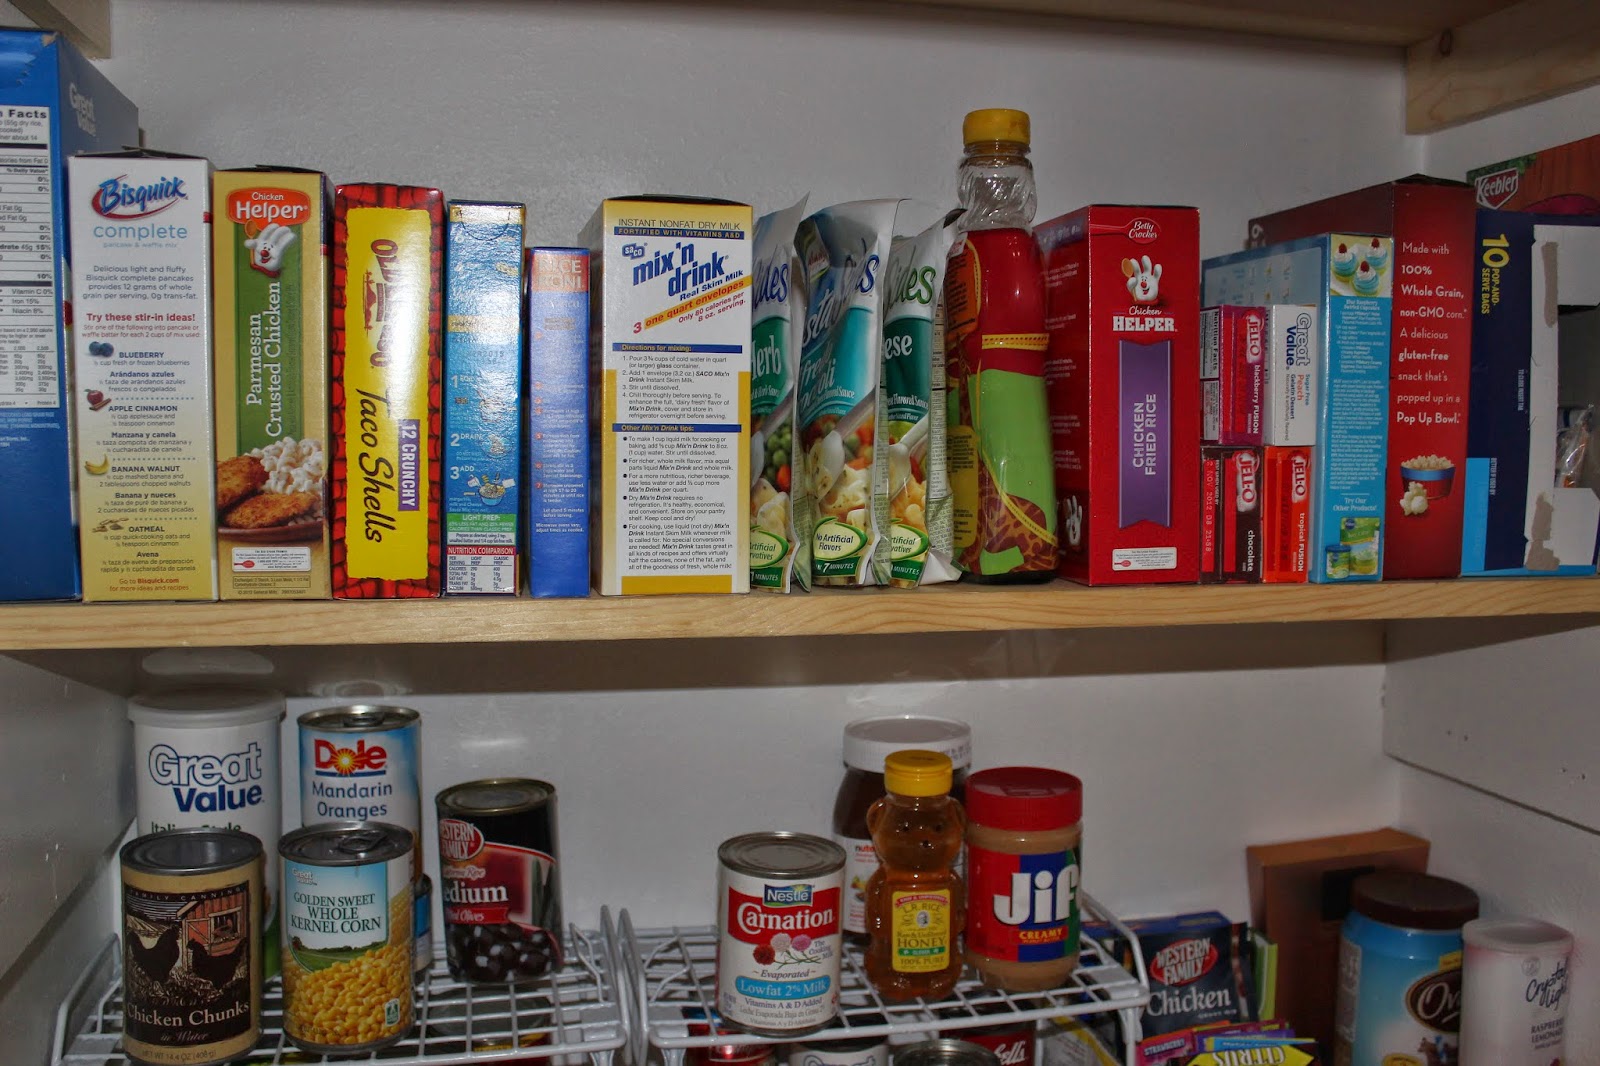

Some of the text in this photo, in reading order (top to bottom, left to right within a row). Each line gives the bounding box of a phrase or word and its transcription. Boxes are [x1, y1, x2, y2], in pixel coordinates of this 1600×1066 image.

[9, 109, 47, 119] Facts
[1476, 173, 1518, 199] Keebler
[100, 177, 187, 214] Bisquick
[251, 192, 284, 202] Chicken
[236, 201, 305, 221] Helper
[94, 224, 187, 242] complete
[660, 220, 694, 228] NONFAT
[720, 222, 740, 230] MILK
[1128, 228, 1158, 239] Crocker
[1133, 221, 1154, 232] Betty
[625, 245, 643, 256] saco
[1402, 242, 1449, 255] Made with
[1482, 233, 1509, 267] 10
[130, 266, 147, 274] light
[167, 266, 186, 274] fluffy
[633, 251, 674, 286] mix
[668, 251, 725, 297] drink
[1401, 265, 1432, 275] 100%
[680, 270, 743, 301] Real Skim Milk
[1401, 284, 1464, 299] Whole Grain,
[1481, 268, 1490, 314] SERVE BAGS
[1492, 268, 1500, 307] POP-AND-
[633, 280, 744, 334] 3 one quart envelopes
[678, 292, 744, 323] Only 80 calories per
[705, 312, 716, 320] oz.
[718, 300, 746, 314] serving.
[1129, 305, 1162, 316] Chicken
[1400, 307, 1444, 318] non-GMO
[87, 313, 195, 323] Try these stir-in ideas!
[1112, 316, 1175, 332] HELPER
[1296, 313, 1312, 366] Great
[1410, 330, 1448, 339] delicious
[1286, 326, 1296, 366] Value
[245, 313, 263, 406] Parmesan
[264, 282, 282, 437] Crusted Chicken
[1399, 351, 1448, 362] gluten-free
[1398, 371, 1448, 381] snack that's
[1397, 393, 1429, 404] popped
[1432, 396, 1445, 405] up
[1447, 394, 1453, 403] in
[356, 387, 393, 449] Taco
[1397, 411, 1416, 424] Pop
[1418, 412, 1432, 425] Up
[1133, 402, 1144, 468] CHICKEN
[1146, 394, 1156, 475] FRIED RICE
[400, 422, 418, 507] 12 CRUNCHY
[450, 466, 459, 479] 3
[358, 452, 396, 543] Shells
[1344, 497, 1353, 505] Try
[1333, 504, 1349, 512] Other
[816, 531, 854, 543] No Artificial
[819, 543, 841, 551] Flavors
[1247, 530, 1255, 571] chocolate
[823, 562, 854, 572] 7 MINUTES
[314, 739, 387, 770] Dole
[148, 742, 262, 786] Great
[174, 784, 262, 812] Value
[312, 782, 392, 798] Mandarin
[317, 802, 387, 820] Oranges
[441, 824, 475, 842] ESTERN
[441, 841, 470, 860] AMILY
[294, 893, 376, 907] GOLDEN SWEET
[444, 881, 508, 903] edium
[767, 890, 808, 903] Nestlé
[993, 864, 1080, 926] Jif
[308, 906, 359, 919] WHOLE
[460, 911, 484, 922] Olives
[903, 903, 942, 914] L.R. RICE
[290, 917, 381, 934] KERNEL CORN
[737, 902, 833, 935] Carnation
[898, 937, 946, 948] HONEY
[1019, 929, 1063, 940] CREAMY
[900, 956, 945, 965] 100% PURE
[1156, 938, 1210, 969] WESTERN
[761, 969, 810, 979] Evaporated
[1164, 956, 1204, 986] FAMILY
[741, 980, 827, 996] Lowfat 2% Milk
[1526, 957, 1569, 1006] Crystal
[1147, 987, 1231, 1017] Chicken
[127, 1002, 249, 1027] Chicken Chunks
[161, 1031, 209, 1041] in Water
[1143, 1038, 1185, 1057] STRAWBERRY
